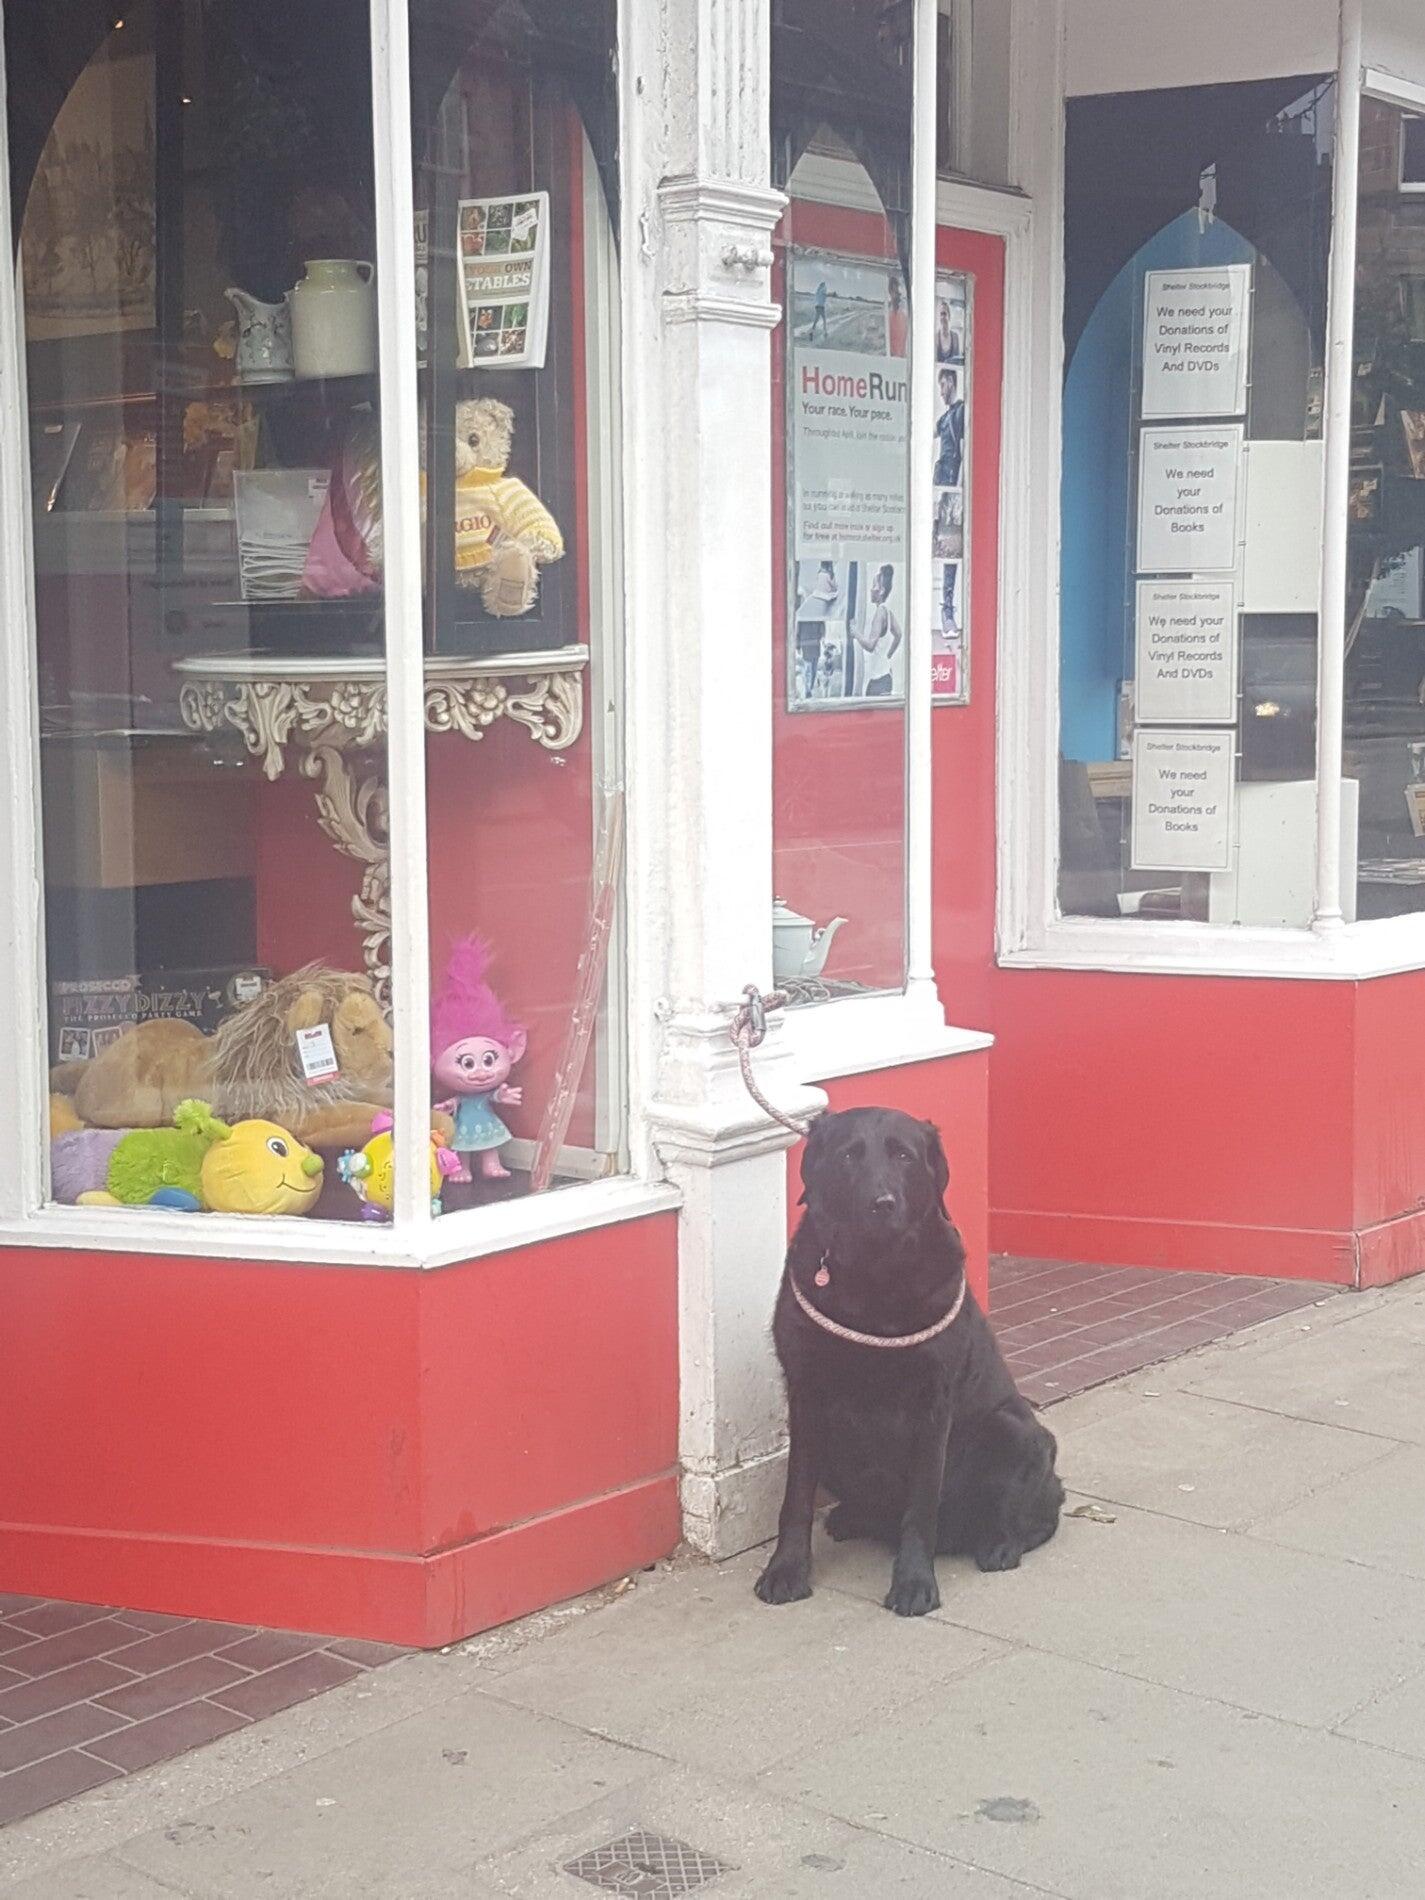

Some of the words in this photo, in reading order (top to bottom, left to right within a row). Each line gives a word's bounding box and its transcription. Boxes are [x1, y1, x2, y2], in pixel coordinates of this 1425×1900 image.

[505, 260, 532, 274] OWN
[1162, 283, 1187, 291] Shelter
[1189, 282, 1230, 291] Stockbridge
[1157, 306, 1175, 317] We
[1178, 306, 1205, 317] need
[1209, 306, 1232, 319] your
[1159, 324, 1214, 336] Donations
[1217, 323, 1229, 335] of
[1154, 342, 1181, 356] Vinyl
[1184, 342, 1230, 353] Records
[1162, 360, 1185, 372] And
[1187, 360, 1220, 372] DVDs
[802, 366, 908, 402] HomeRun
[802, 402, 825, 415] Your
[848, 406, 869, 418] Your
[1153, 441, 1181, 450] Shelter
[1183, 440, 1229, 450] Stockbridge
[1165, 468, 1183, 479] We
[1186, 468, 1214, 479] need
[1177, 486, 1201, 499] your
[1154, 504, 1208, 515] Donations
[1211, 503, 1223, 515] of
[1171, 522, 1205, 533] Books
[1153, 592, 1178, 600] Shelter
[1179, 592, 1220, 601] Stockbridge
[1148, 615, 1166, 627] We
[1169, 615, 1196, 627] need
[1200, 615, 1224, 629] your
[1152, 633, 1206, 644] Donations
[1209, 632, 1220, 644] of
[1148, 651, 1175, 664] Vinyl
[1178, 650, 1223, 661] Records
[1157, 668, 1179, 679] And
[1182, 668, 1213, 680] DVDs
[1147, 742, 1174, 751] Shelter
[1176, 742, 1221, 753] Stockbridge
[1159, 769, 1177, 780] We
[1180, 769, 1207, 780] need
[1170, 787, 1194, 799] your
[1148, 803, 1202, 815] Donations
[1205, 803, 1217, 815] of
[1165, 821, 1198, 832] Books
[60, 980, 131, 994] PROSECCO
[134, 991, 206, 1012] DIZZY
[175, 1010, 203, 1018] GAME
